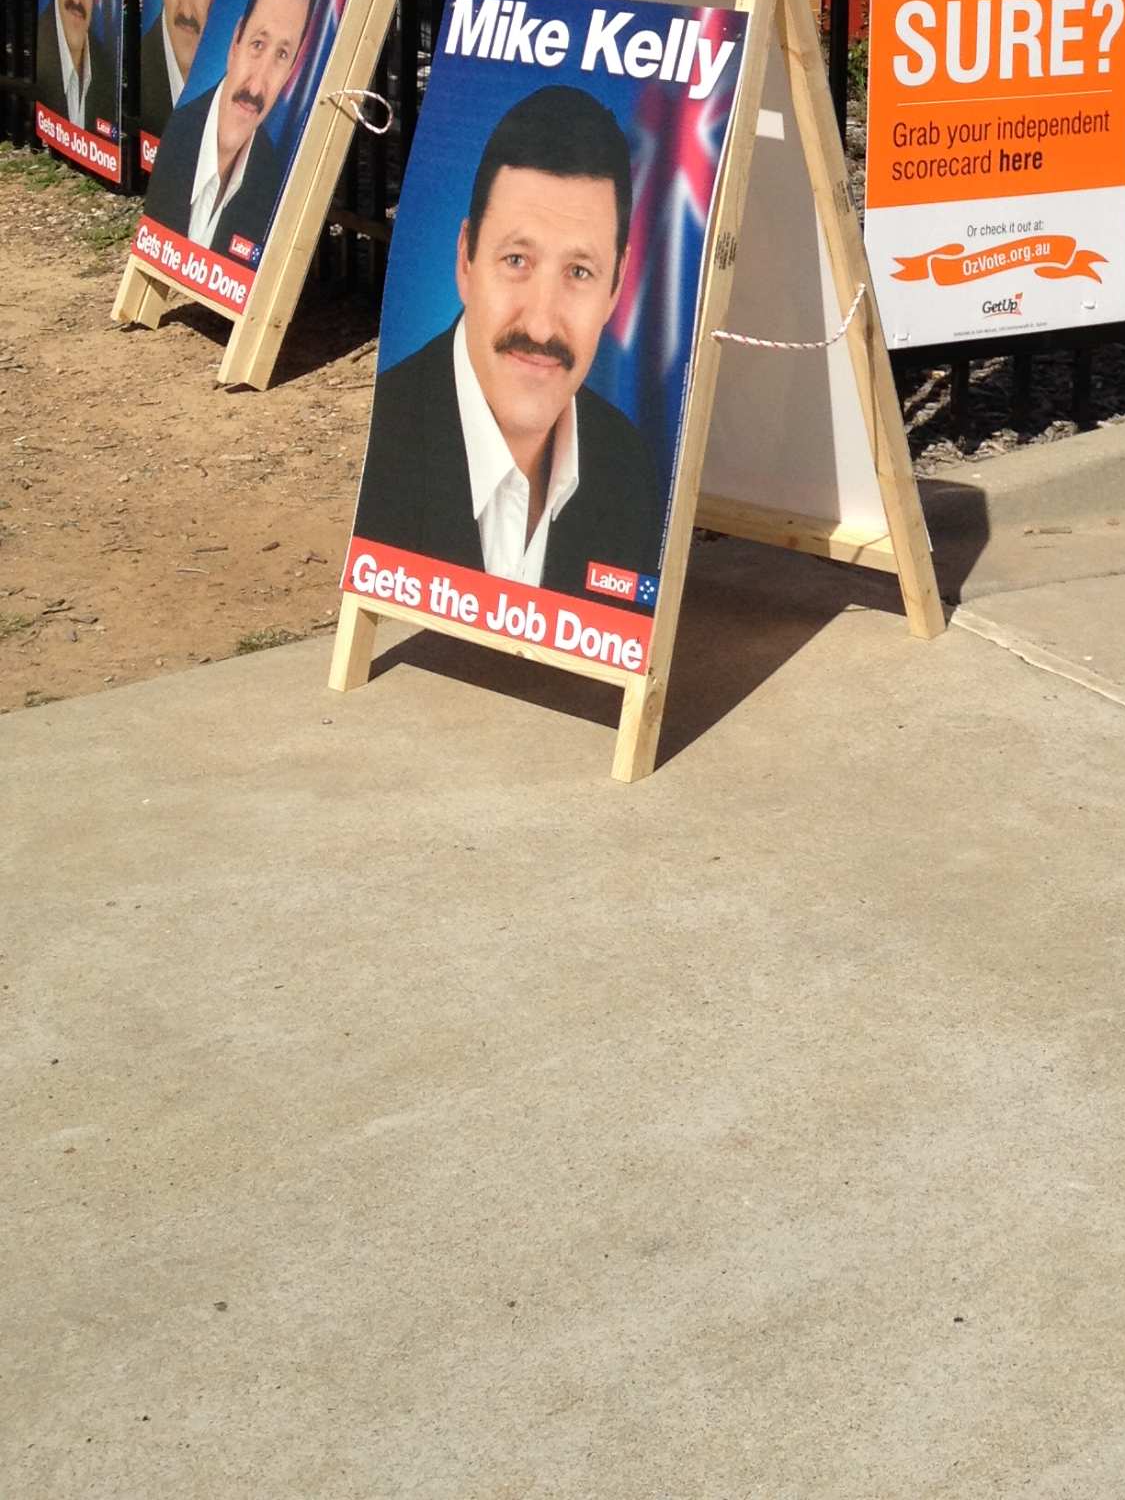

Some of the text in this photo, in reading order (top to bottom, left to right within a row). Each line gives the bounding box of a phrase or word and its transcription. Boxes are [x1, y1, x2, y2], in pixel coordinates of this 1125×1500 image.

[580, 8, 736, 101] Kelly
[38, 110, 117, 172] Gets the Job Done
[893, 109, 1110, 149] Grab your independent
[142, 139, 158, 164] Get
[891, 149, 1043, 182] scorecard here
[967, 219, 1045, 238] Or check it out at:
[136, 224, 247, 304] Gets the Job Done
[963, 242, 1050, 276] OzVote.org.au
[590, 568, 634, 596] Labor
[352, 554, 643, 671] Gets the Job Done
